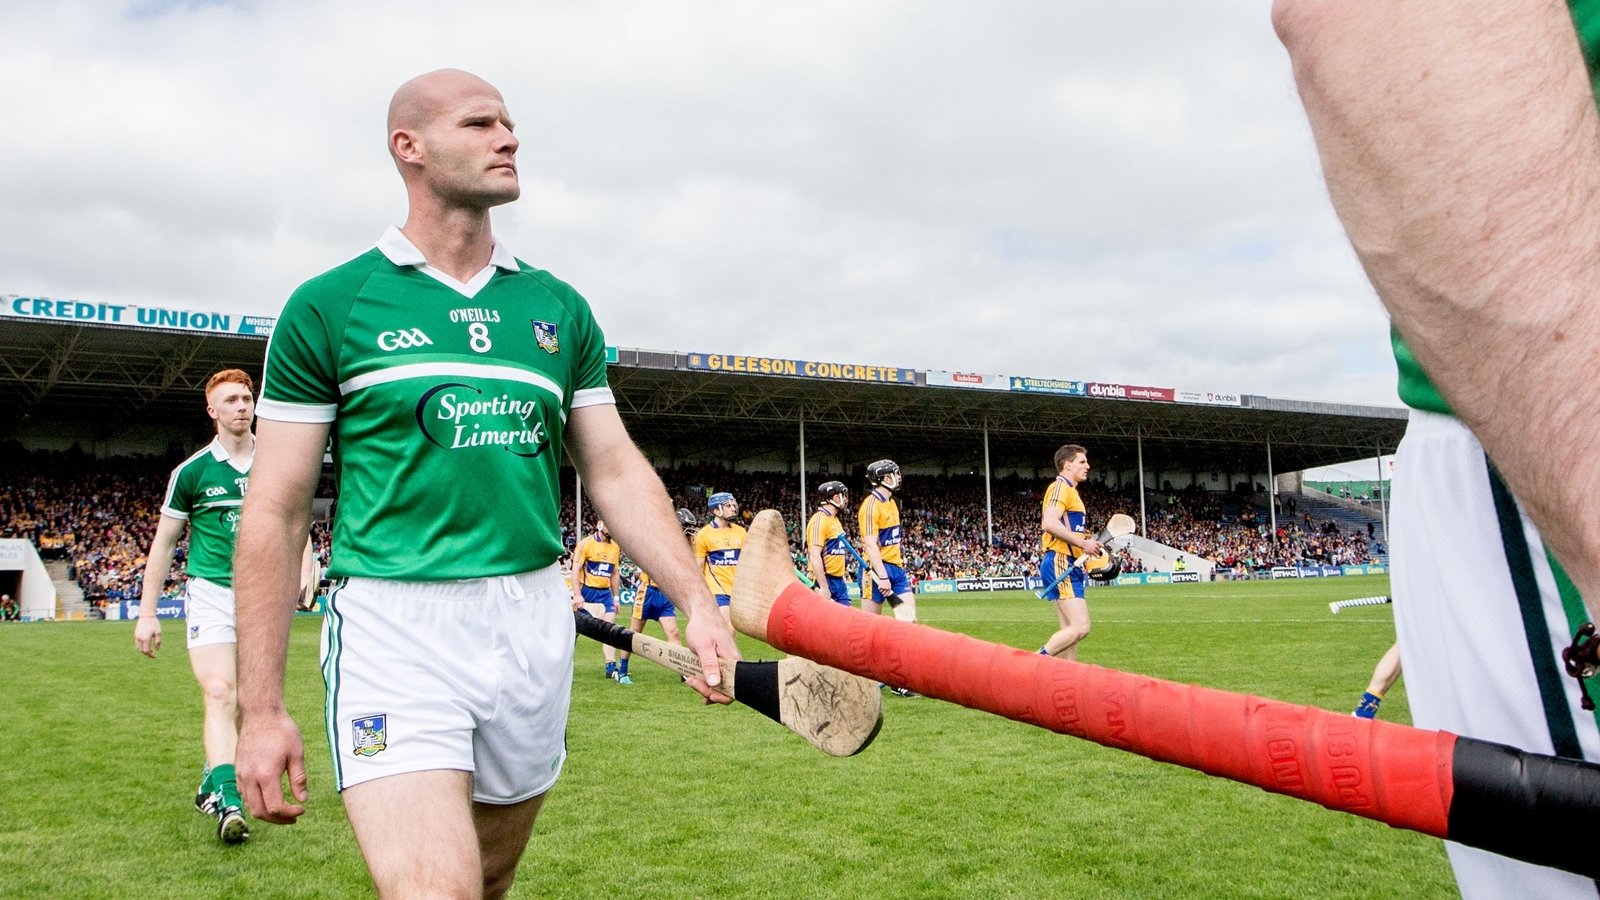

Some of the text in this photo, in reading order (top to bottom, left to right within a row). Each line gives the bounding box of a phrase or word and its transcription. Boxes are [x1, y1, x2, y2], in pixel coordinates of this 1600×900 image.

[12, 297, 231, 331] CREDIT UNION
[449, 308, 501, 323] O'NEILLS
[468, 322, 492, 354] 8
[708, 353, 797, 375] GLEESON
[804, 362, 899, 382] CONCRETE
[1090, 384, 1126, 397] dunbia
[1215, 393, 1237, 402] dunbia
[437, 394, 536, 424] Sporting
[1172, 573, 1199, 582] ETIHAD
[923, 582, 953, 592] Centra
[957, 581, 991, 590] ETIHAD
[992, 580, 1024, 589] ETIHAD
